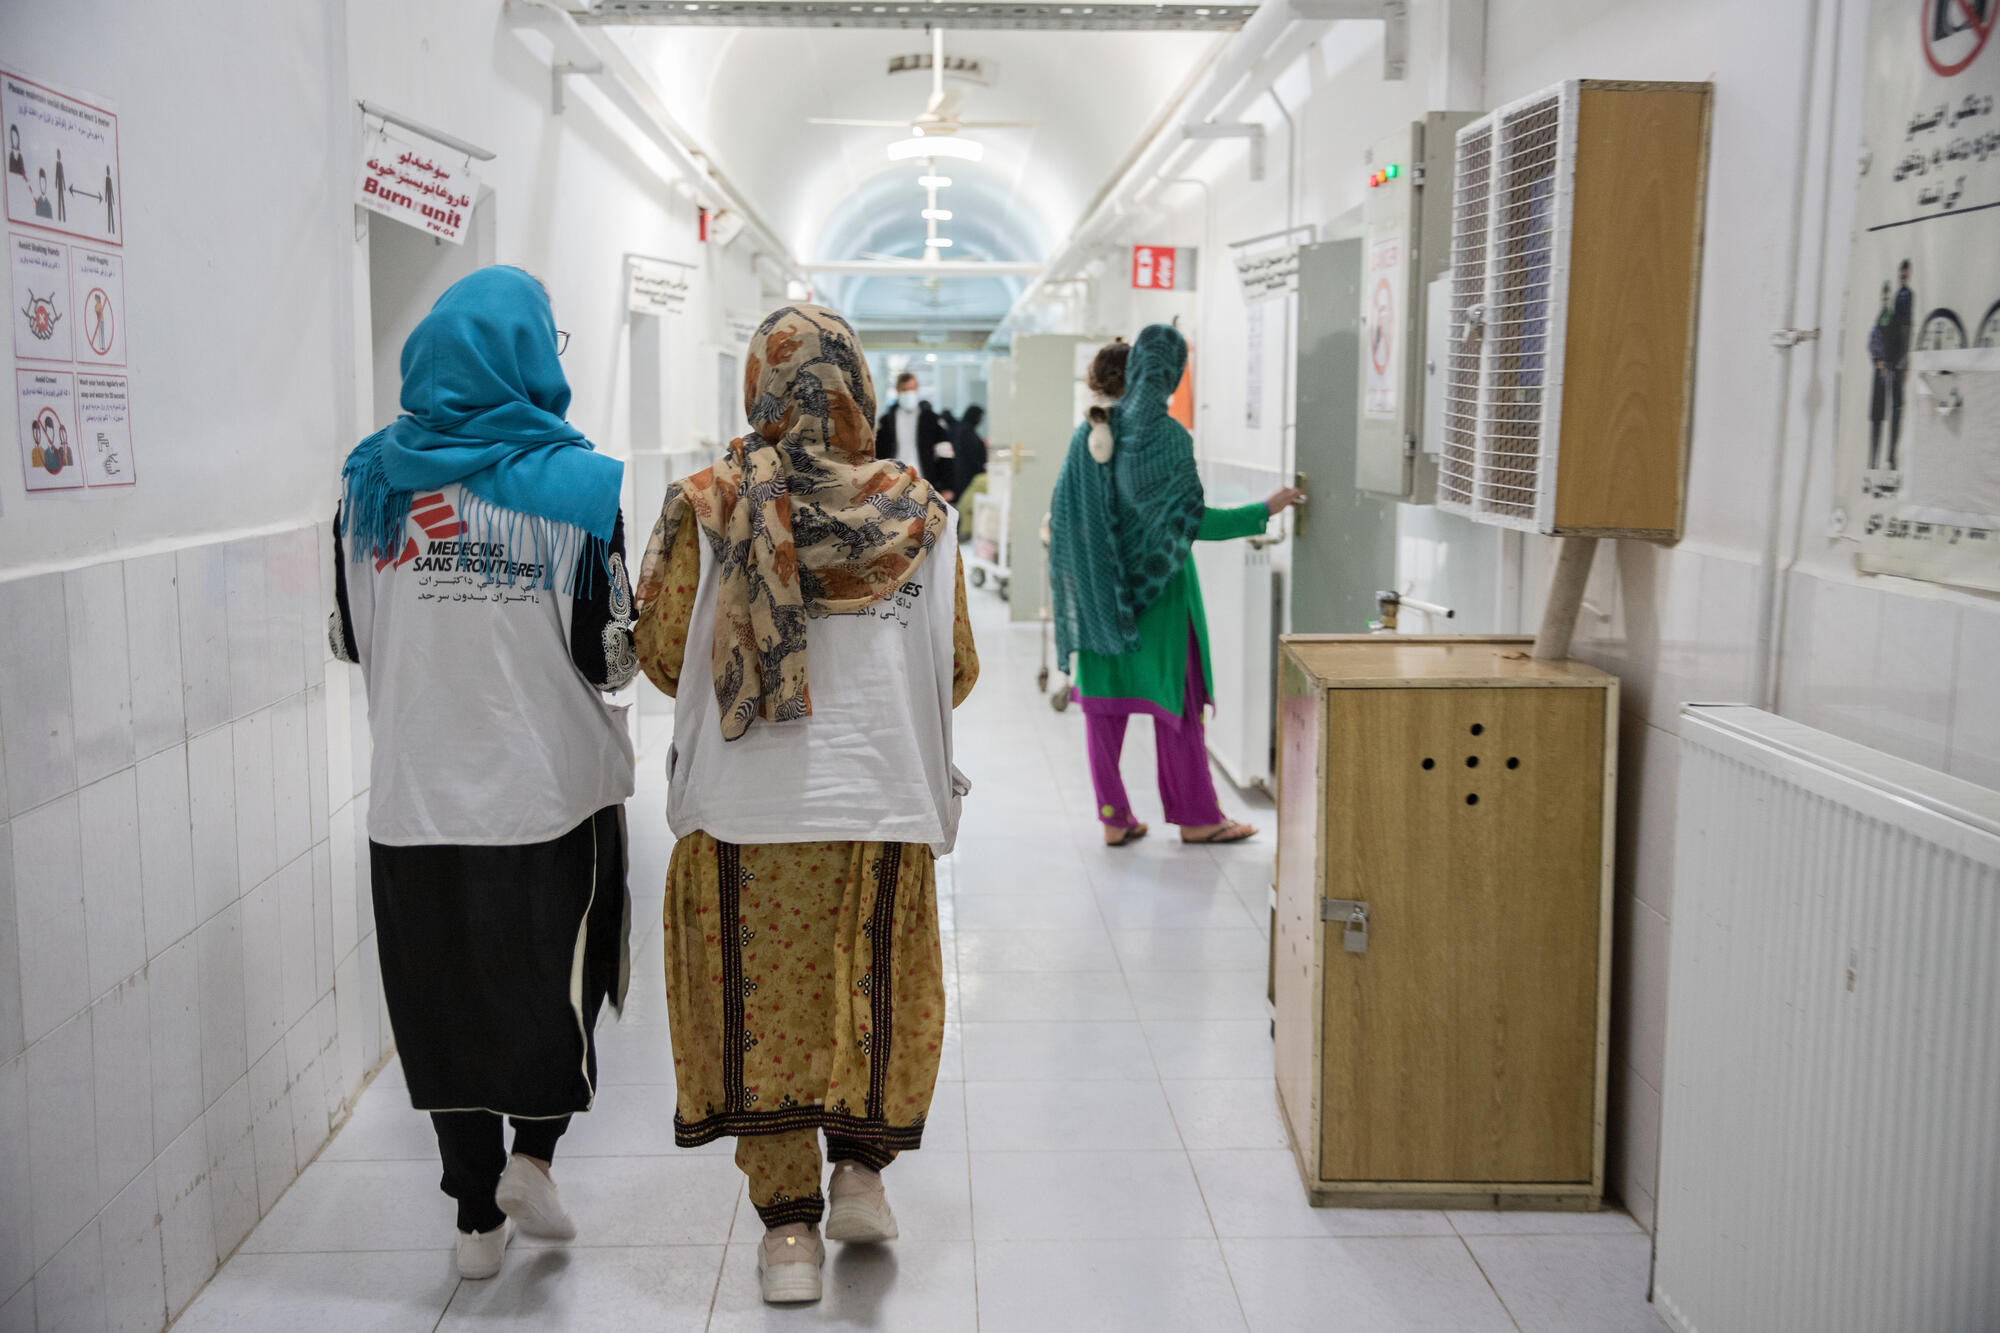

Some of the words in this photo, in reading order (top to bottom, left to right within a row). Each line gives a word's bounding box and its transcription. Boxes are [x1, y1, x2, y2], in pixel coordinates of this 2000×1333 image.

[363, 176, 413, 209] Burn
[421, 203, 462, 229] unit
[426, 221, 455, 238] FW-04
[427, 540, 504, 558] MEDECINS
[413, 557, 453, 572] SANS
[455, 558, 544, 579] FRONTIERES
